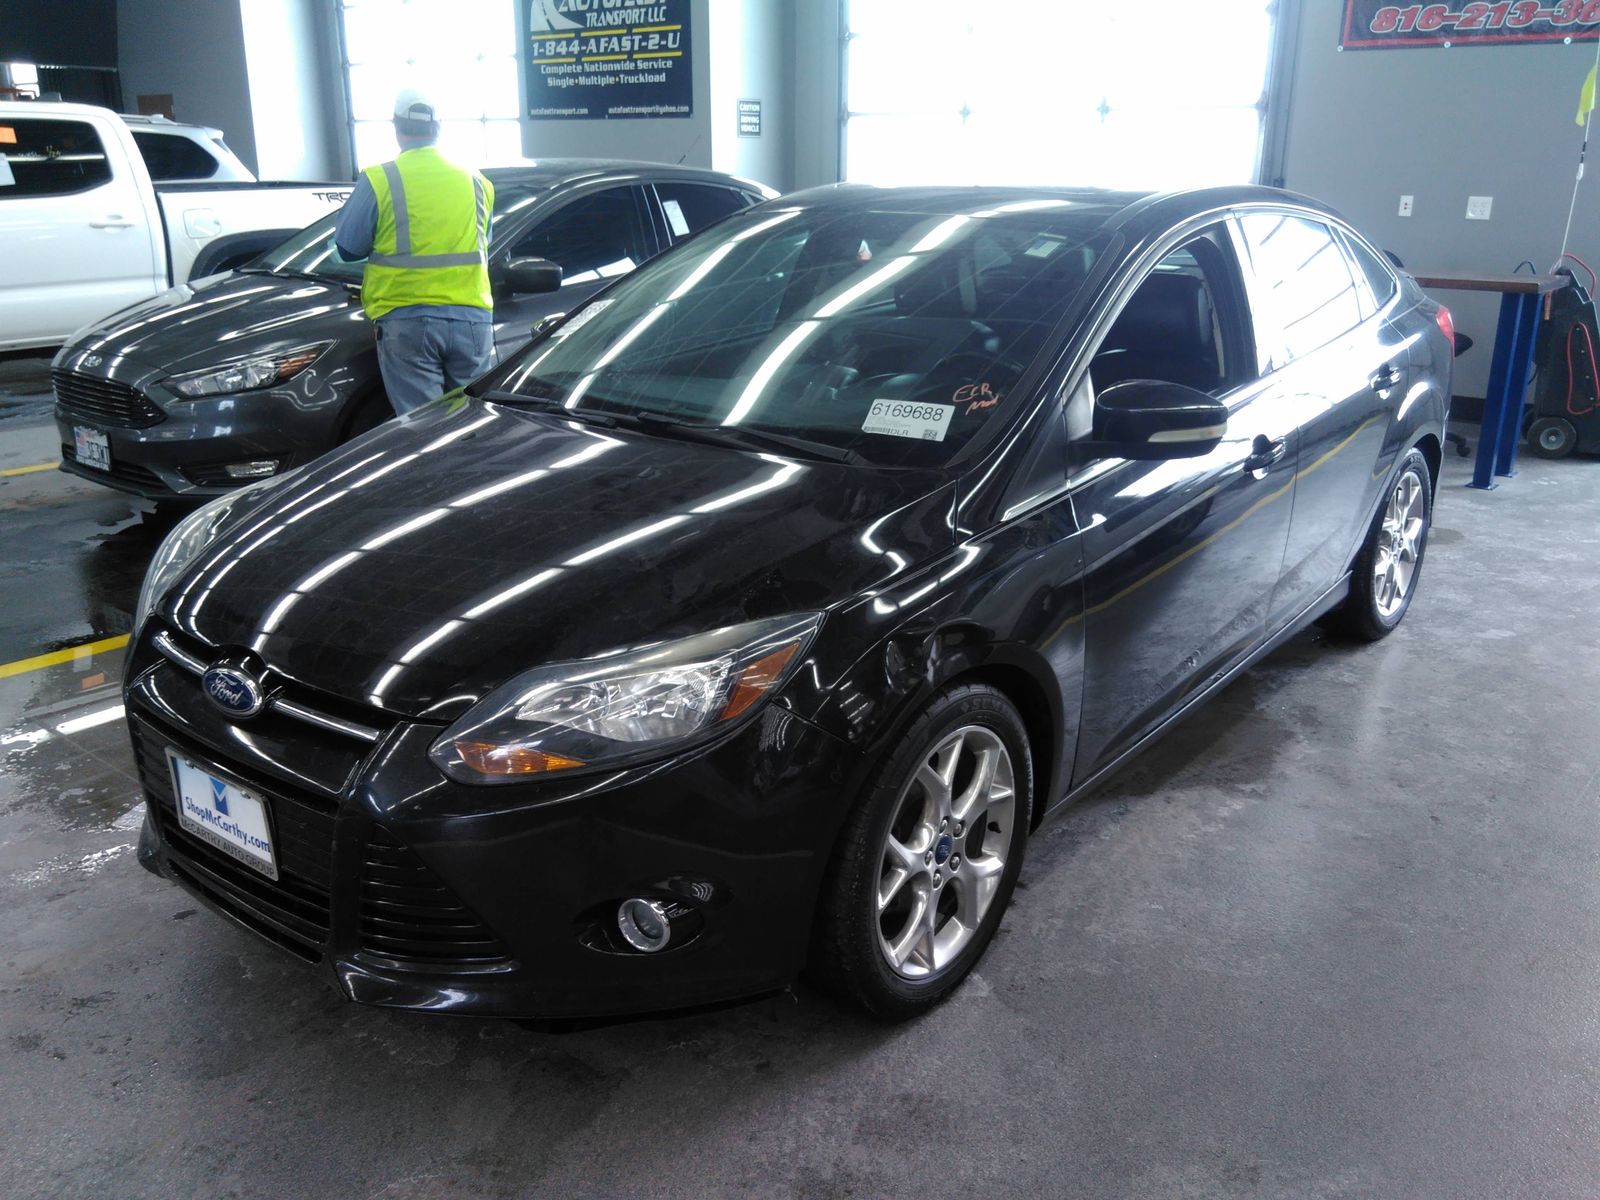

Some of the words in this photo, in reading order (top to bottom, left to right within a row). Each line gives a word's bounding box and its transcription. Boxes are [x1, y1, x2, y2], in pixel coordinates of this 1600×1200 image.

[585, 9, 645, 27] TRANSPORT
[647, 6, 667, 23] LLC
[541, 63, 582, 75] Complete
[584, 61, 635, 73] Nationwide
[637, 59, 673, 70] Service
[871, 402, 944, 422] 6169688
[210, 672, 244, 707] Ford
[185, 796, 271, 853] ShopMcCarthy.com
[222, 842, 245, 860] AUTO
[245, 855, 275, 876] GROUP
